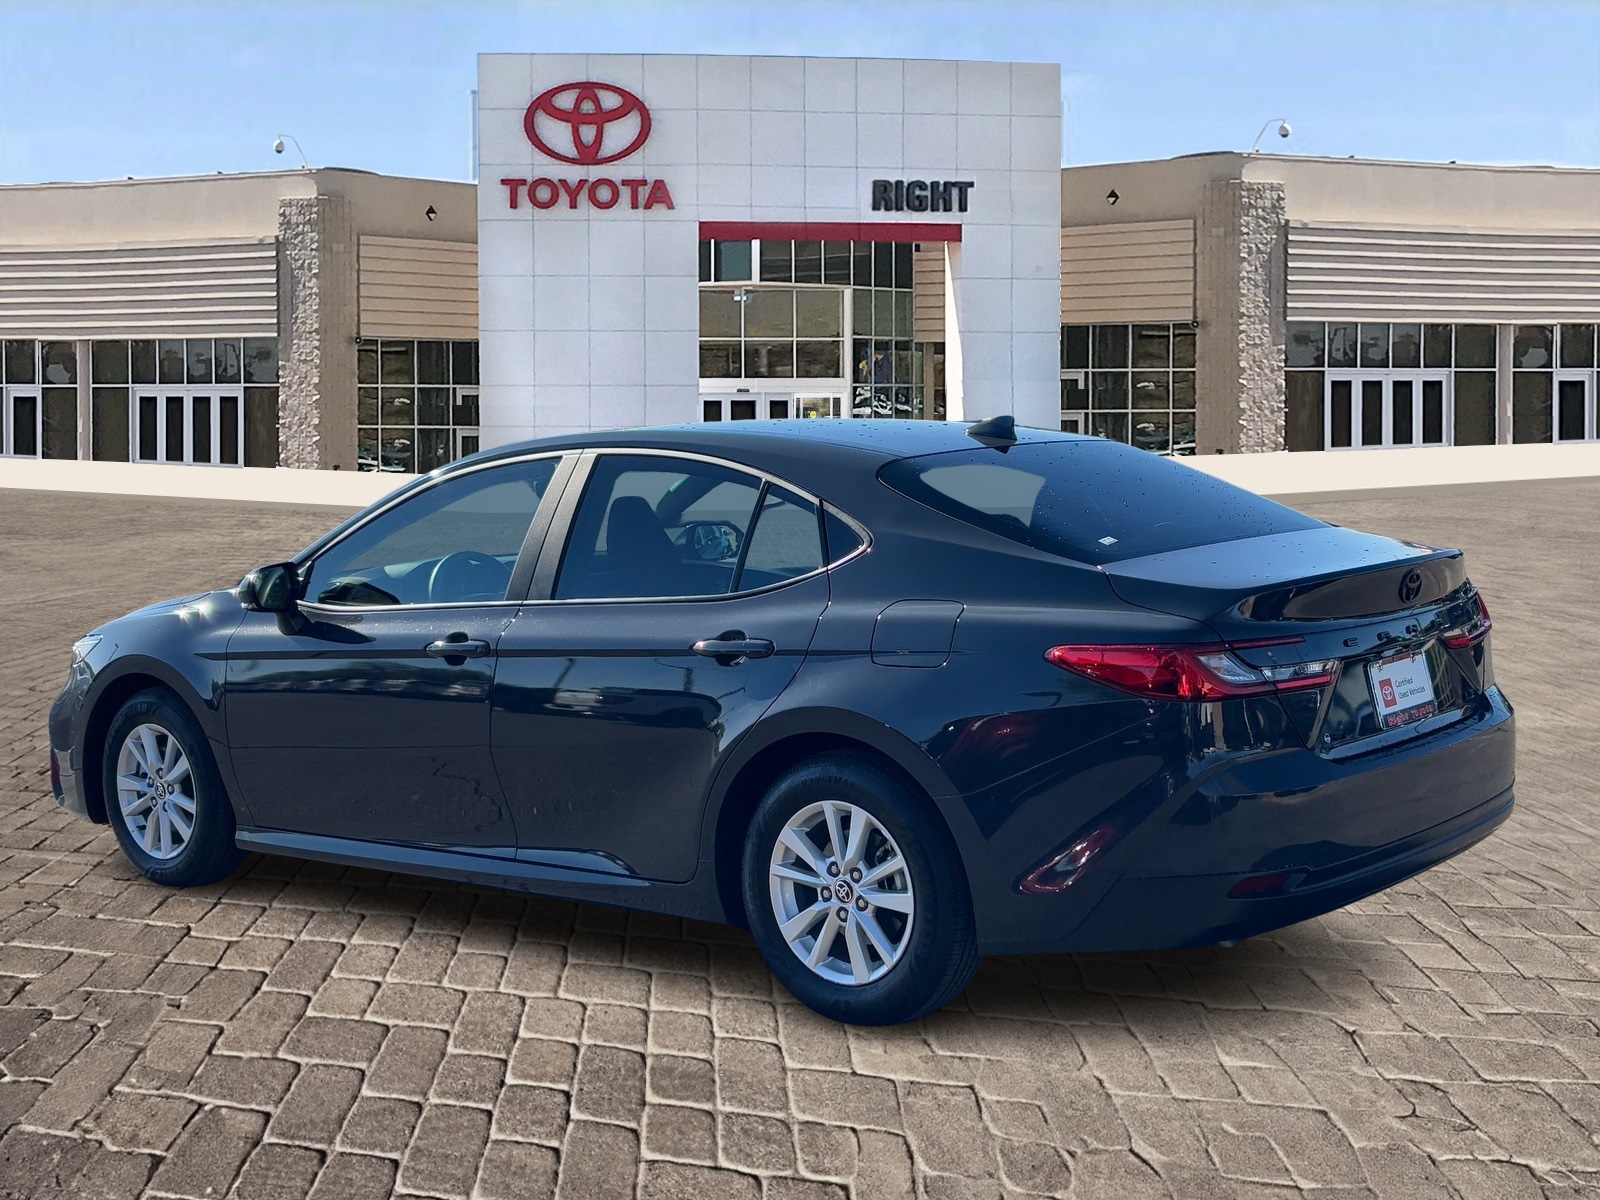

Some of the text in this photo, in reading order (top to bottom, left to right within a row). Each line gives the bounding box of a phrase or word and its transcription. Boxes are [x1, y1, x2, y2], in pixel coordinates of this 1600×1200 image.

[500, 177, 675, 210] TOYOTA
[872, 179, 975, 212] RIGHT
[1395, 676, 1413, 688] Certified
[1398, 686, 1425, 699] Used Vehicles
